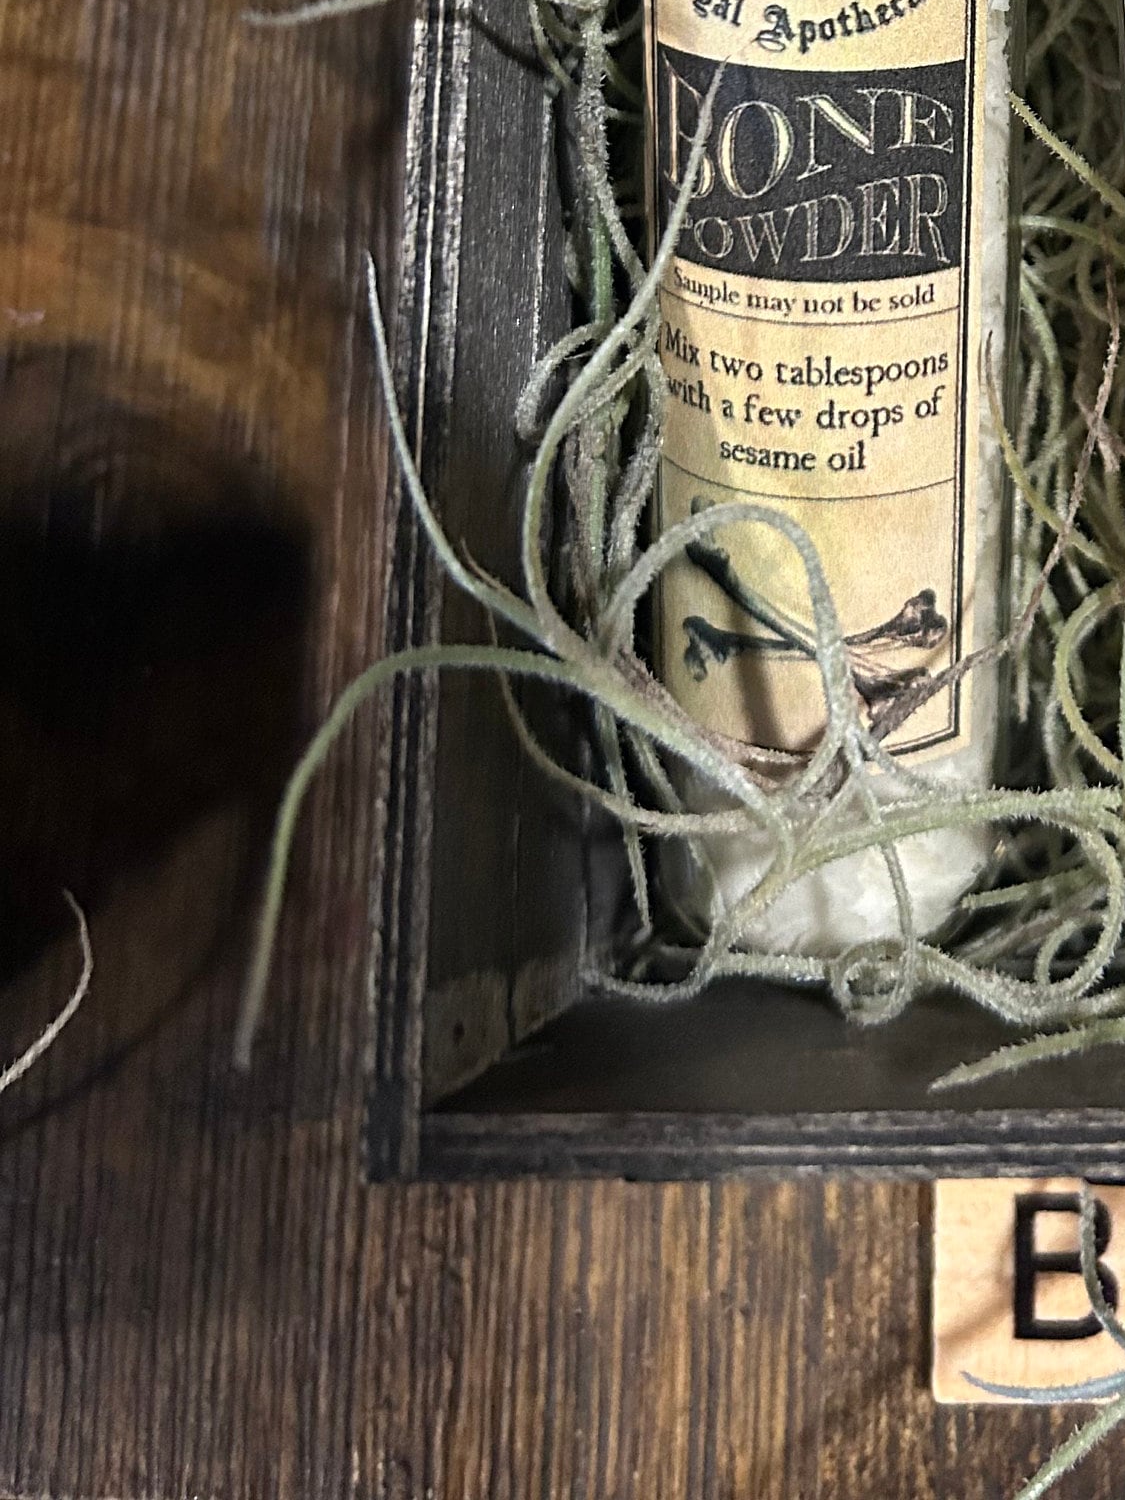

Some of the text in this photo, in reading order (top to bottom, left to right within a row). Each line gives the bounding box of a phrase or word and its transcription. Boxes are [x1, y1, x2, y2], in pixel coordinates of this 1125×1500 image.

[674, 266, 935, 317] Sample may not be sold
[666, 321, 949, 395] Mix two tablespoons
[667, 375, 945, 437] with a few drops of
[720, 439, 866, 471] sesame oil
[1014, 1192, 1120, 1340] B
